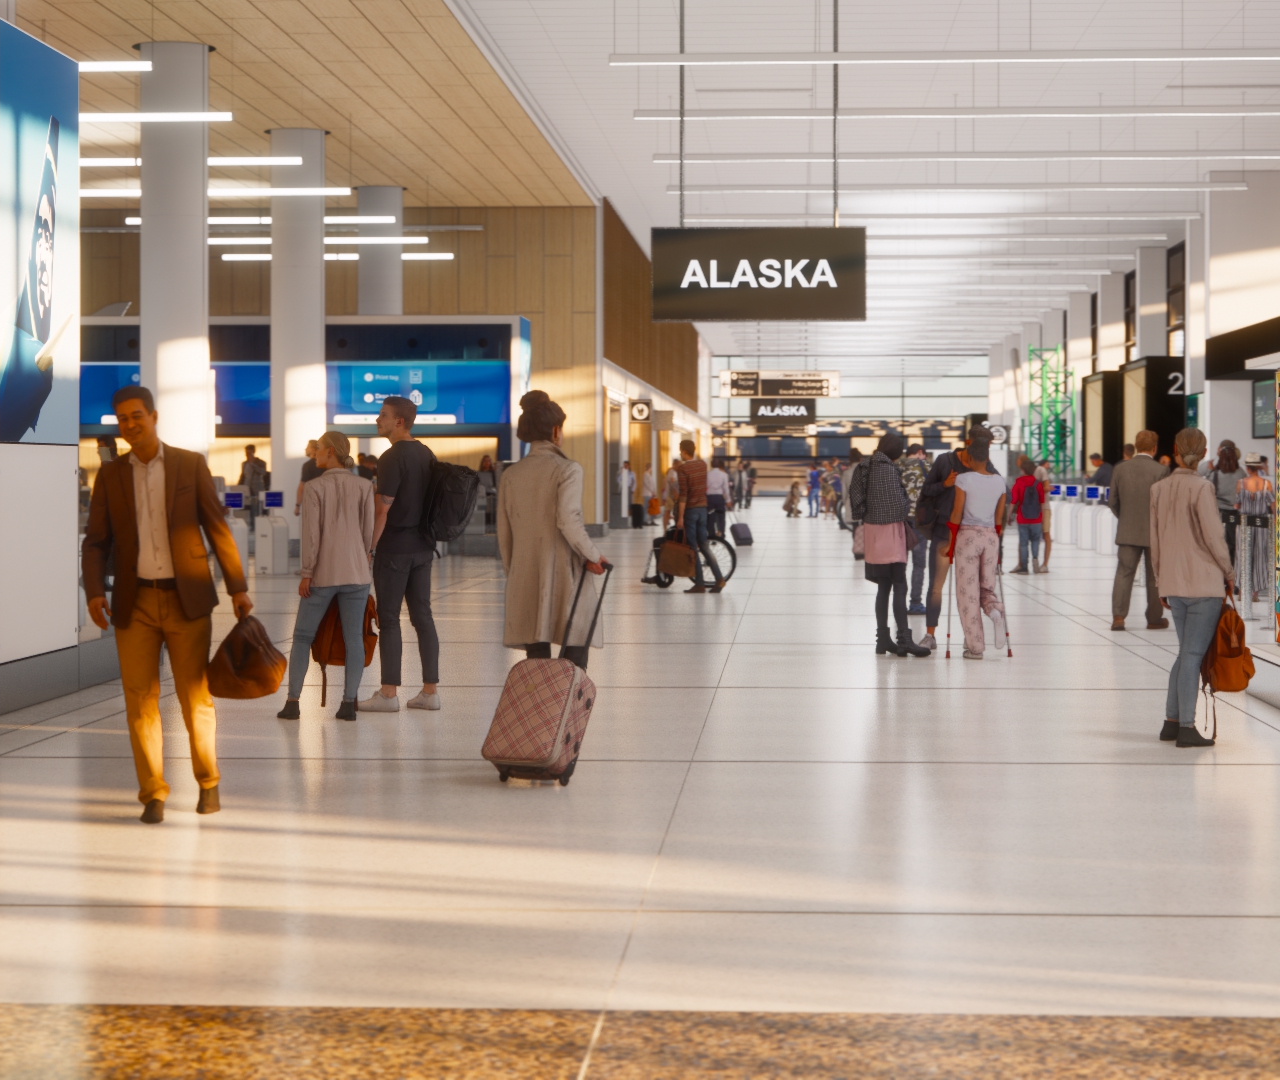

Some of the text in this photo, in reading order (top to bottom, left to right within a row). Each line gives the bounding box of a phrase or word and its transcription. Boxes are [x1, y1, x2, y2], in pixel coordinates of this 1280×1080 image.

[680, 258, 838, 289] ALASKA
[1167, 372, 1184, 395] 2
[757, 405, 808, 415] ALASKA
